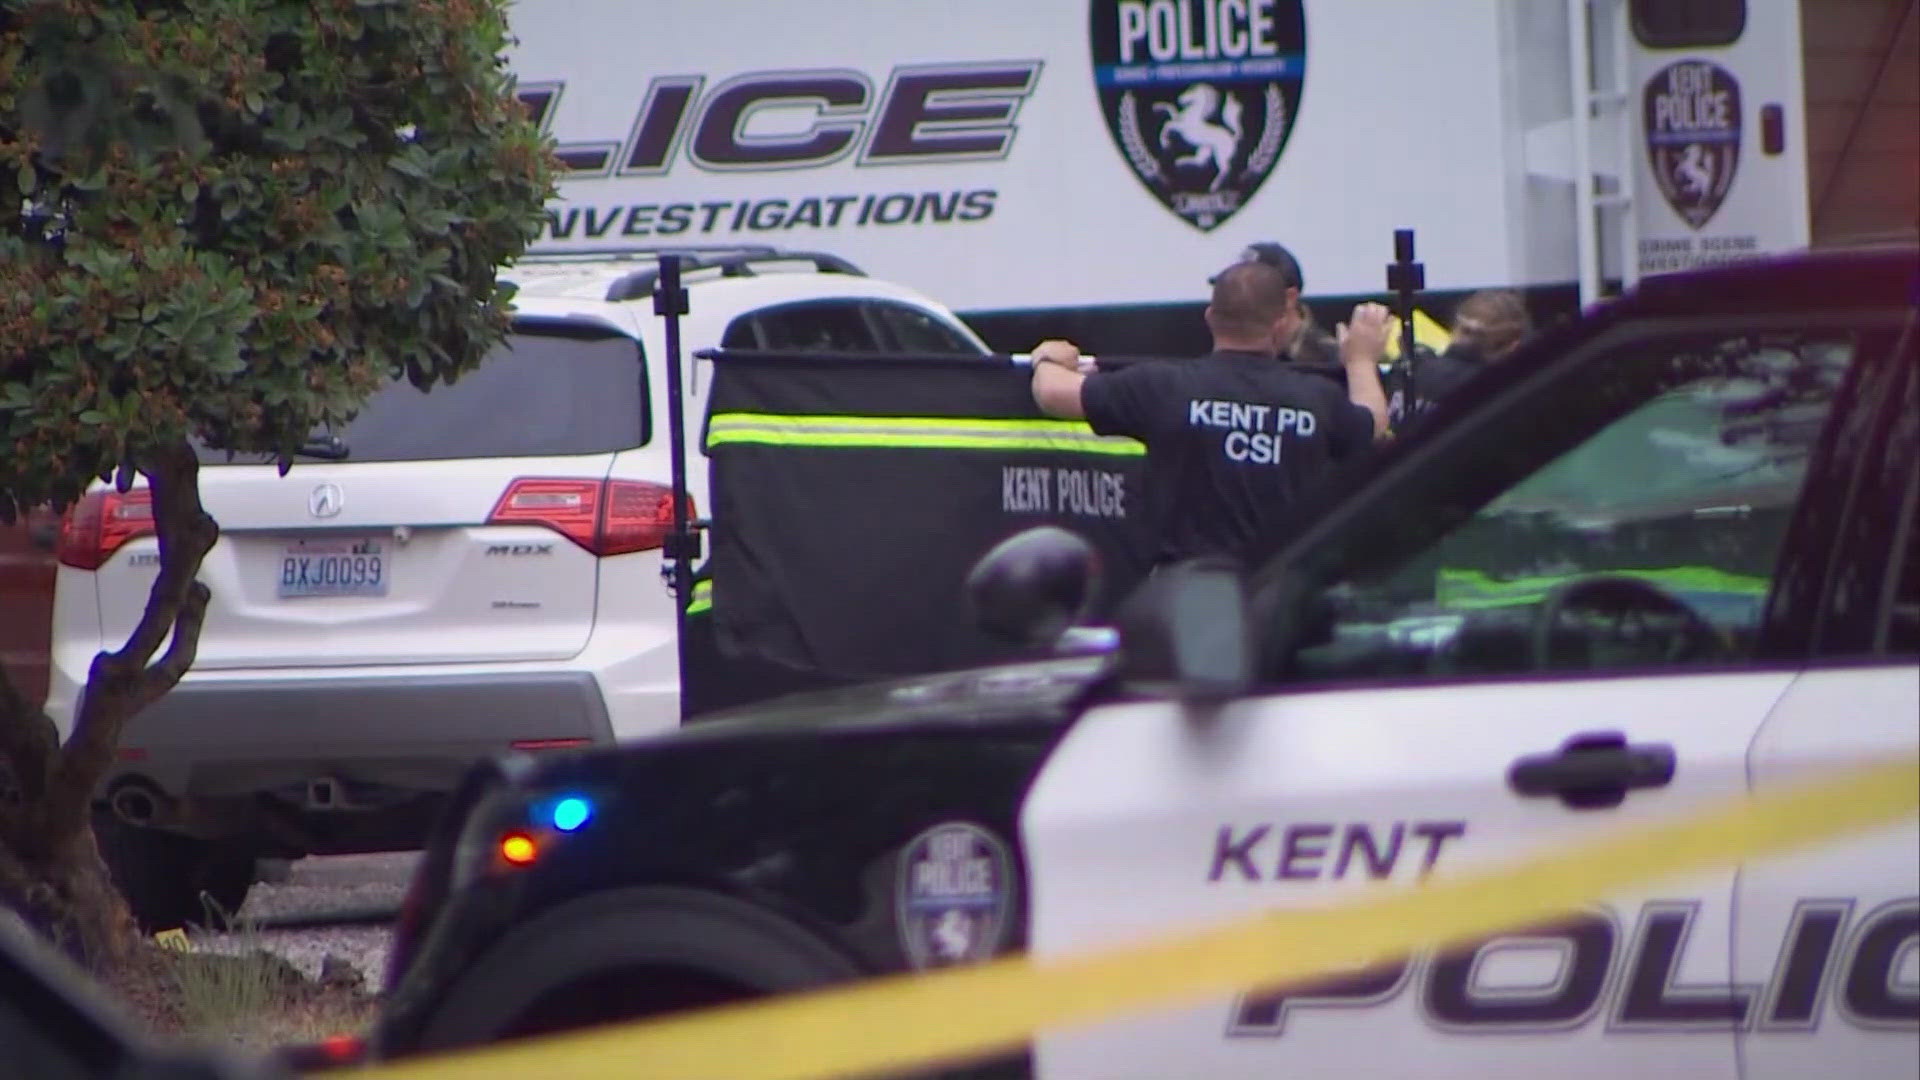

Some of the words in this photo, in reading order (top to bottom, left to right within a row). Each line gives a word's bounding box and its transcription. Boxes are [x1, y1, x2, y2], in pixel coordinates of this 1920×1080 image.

[1118, 0, 1278, 64] POLICE
[512, 60, 1043, 178] LICE
[1655, 92, 1728, 130] POLICE
[550, 189, 997, 240] NVESTIGATIONS
[1190, 401, 1270, 434] KENT
[1278, 407, 1317, 437] PD
[1224, 430, 1282, 465] CSI
[1002, 465, 1050, 513] KENT
[1056, 468, 1126, 517] POLICE
[282, 556, 382, 587] BXJ0099
[1207, 822, 1467, 881] KENT
